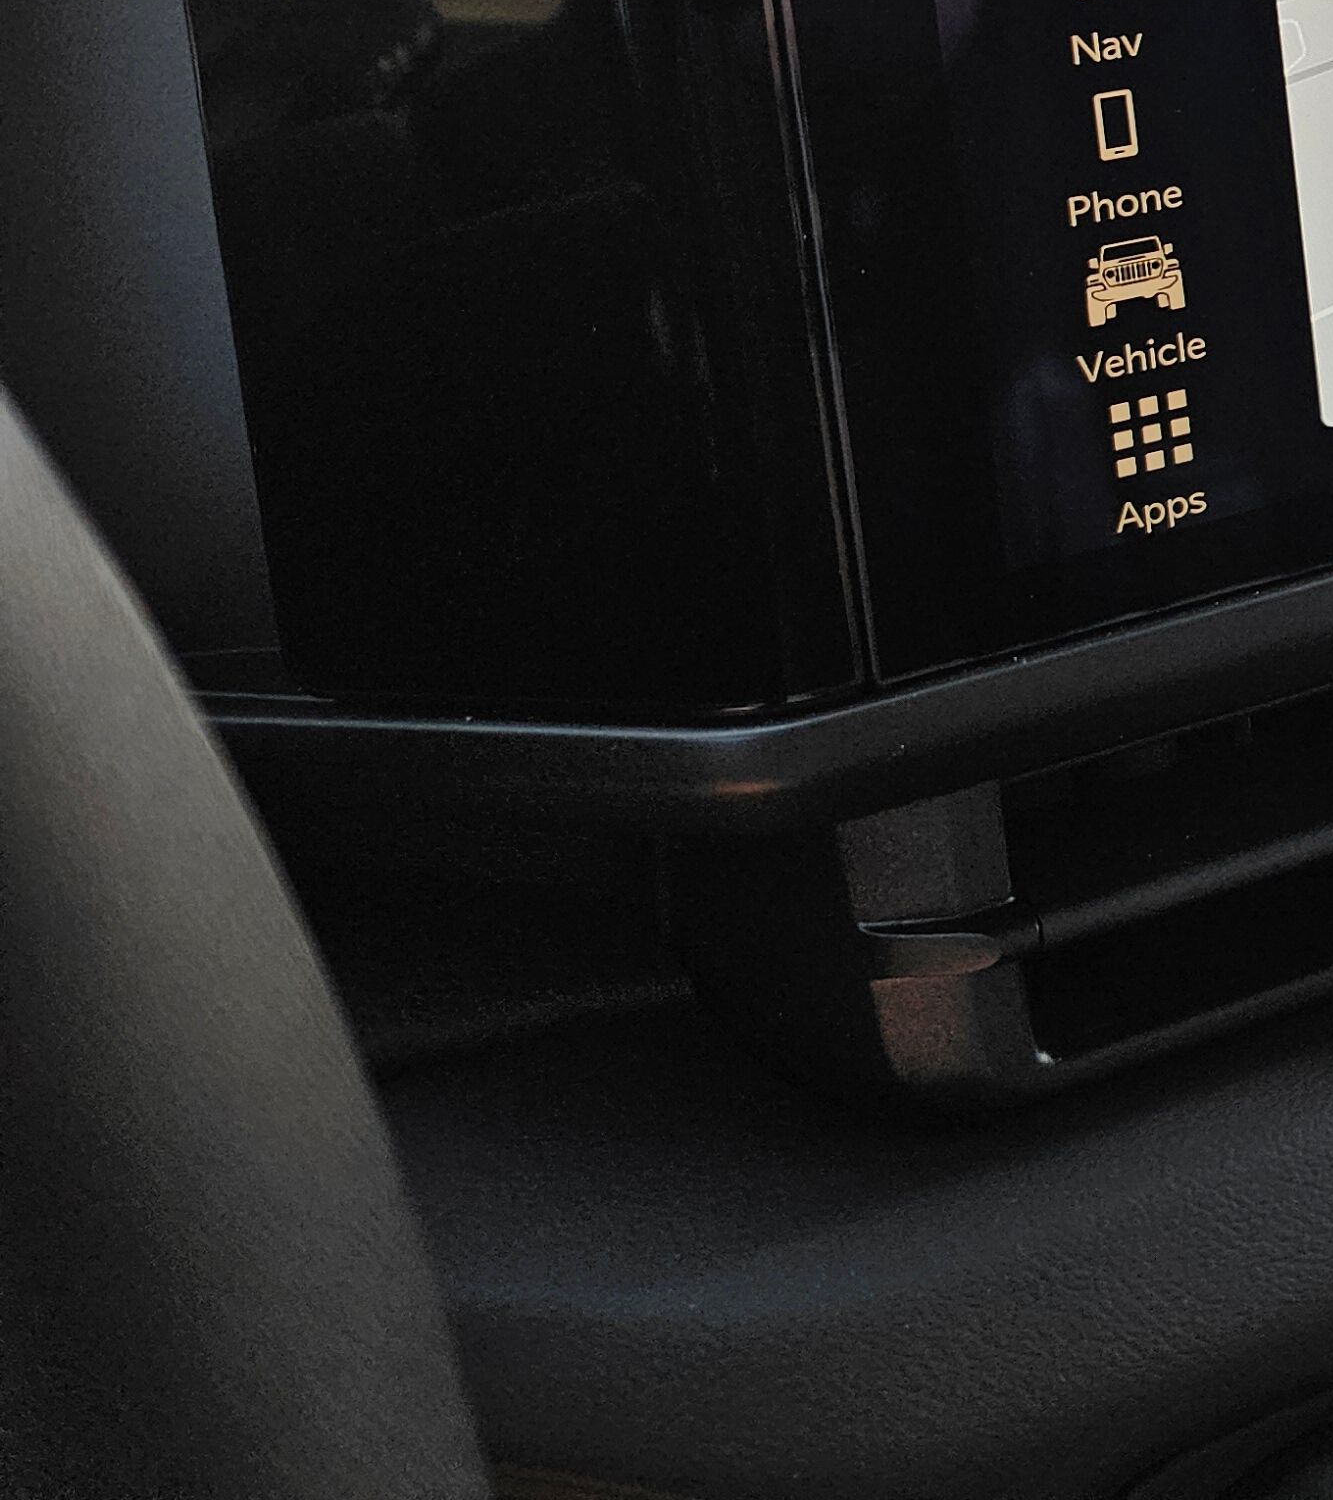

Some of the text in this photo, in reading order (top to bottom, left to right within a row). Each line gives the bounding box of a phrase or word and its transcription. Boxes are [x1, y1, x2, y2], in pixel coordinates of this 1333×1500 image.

[1071, 32, 1143, 65] Nav
[1068, 185, 1183, 227] Phone
[1076, 335, 1206, 383] Vehicle
[1116, 491, 1207, 533] Apps
